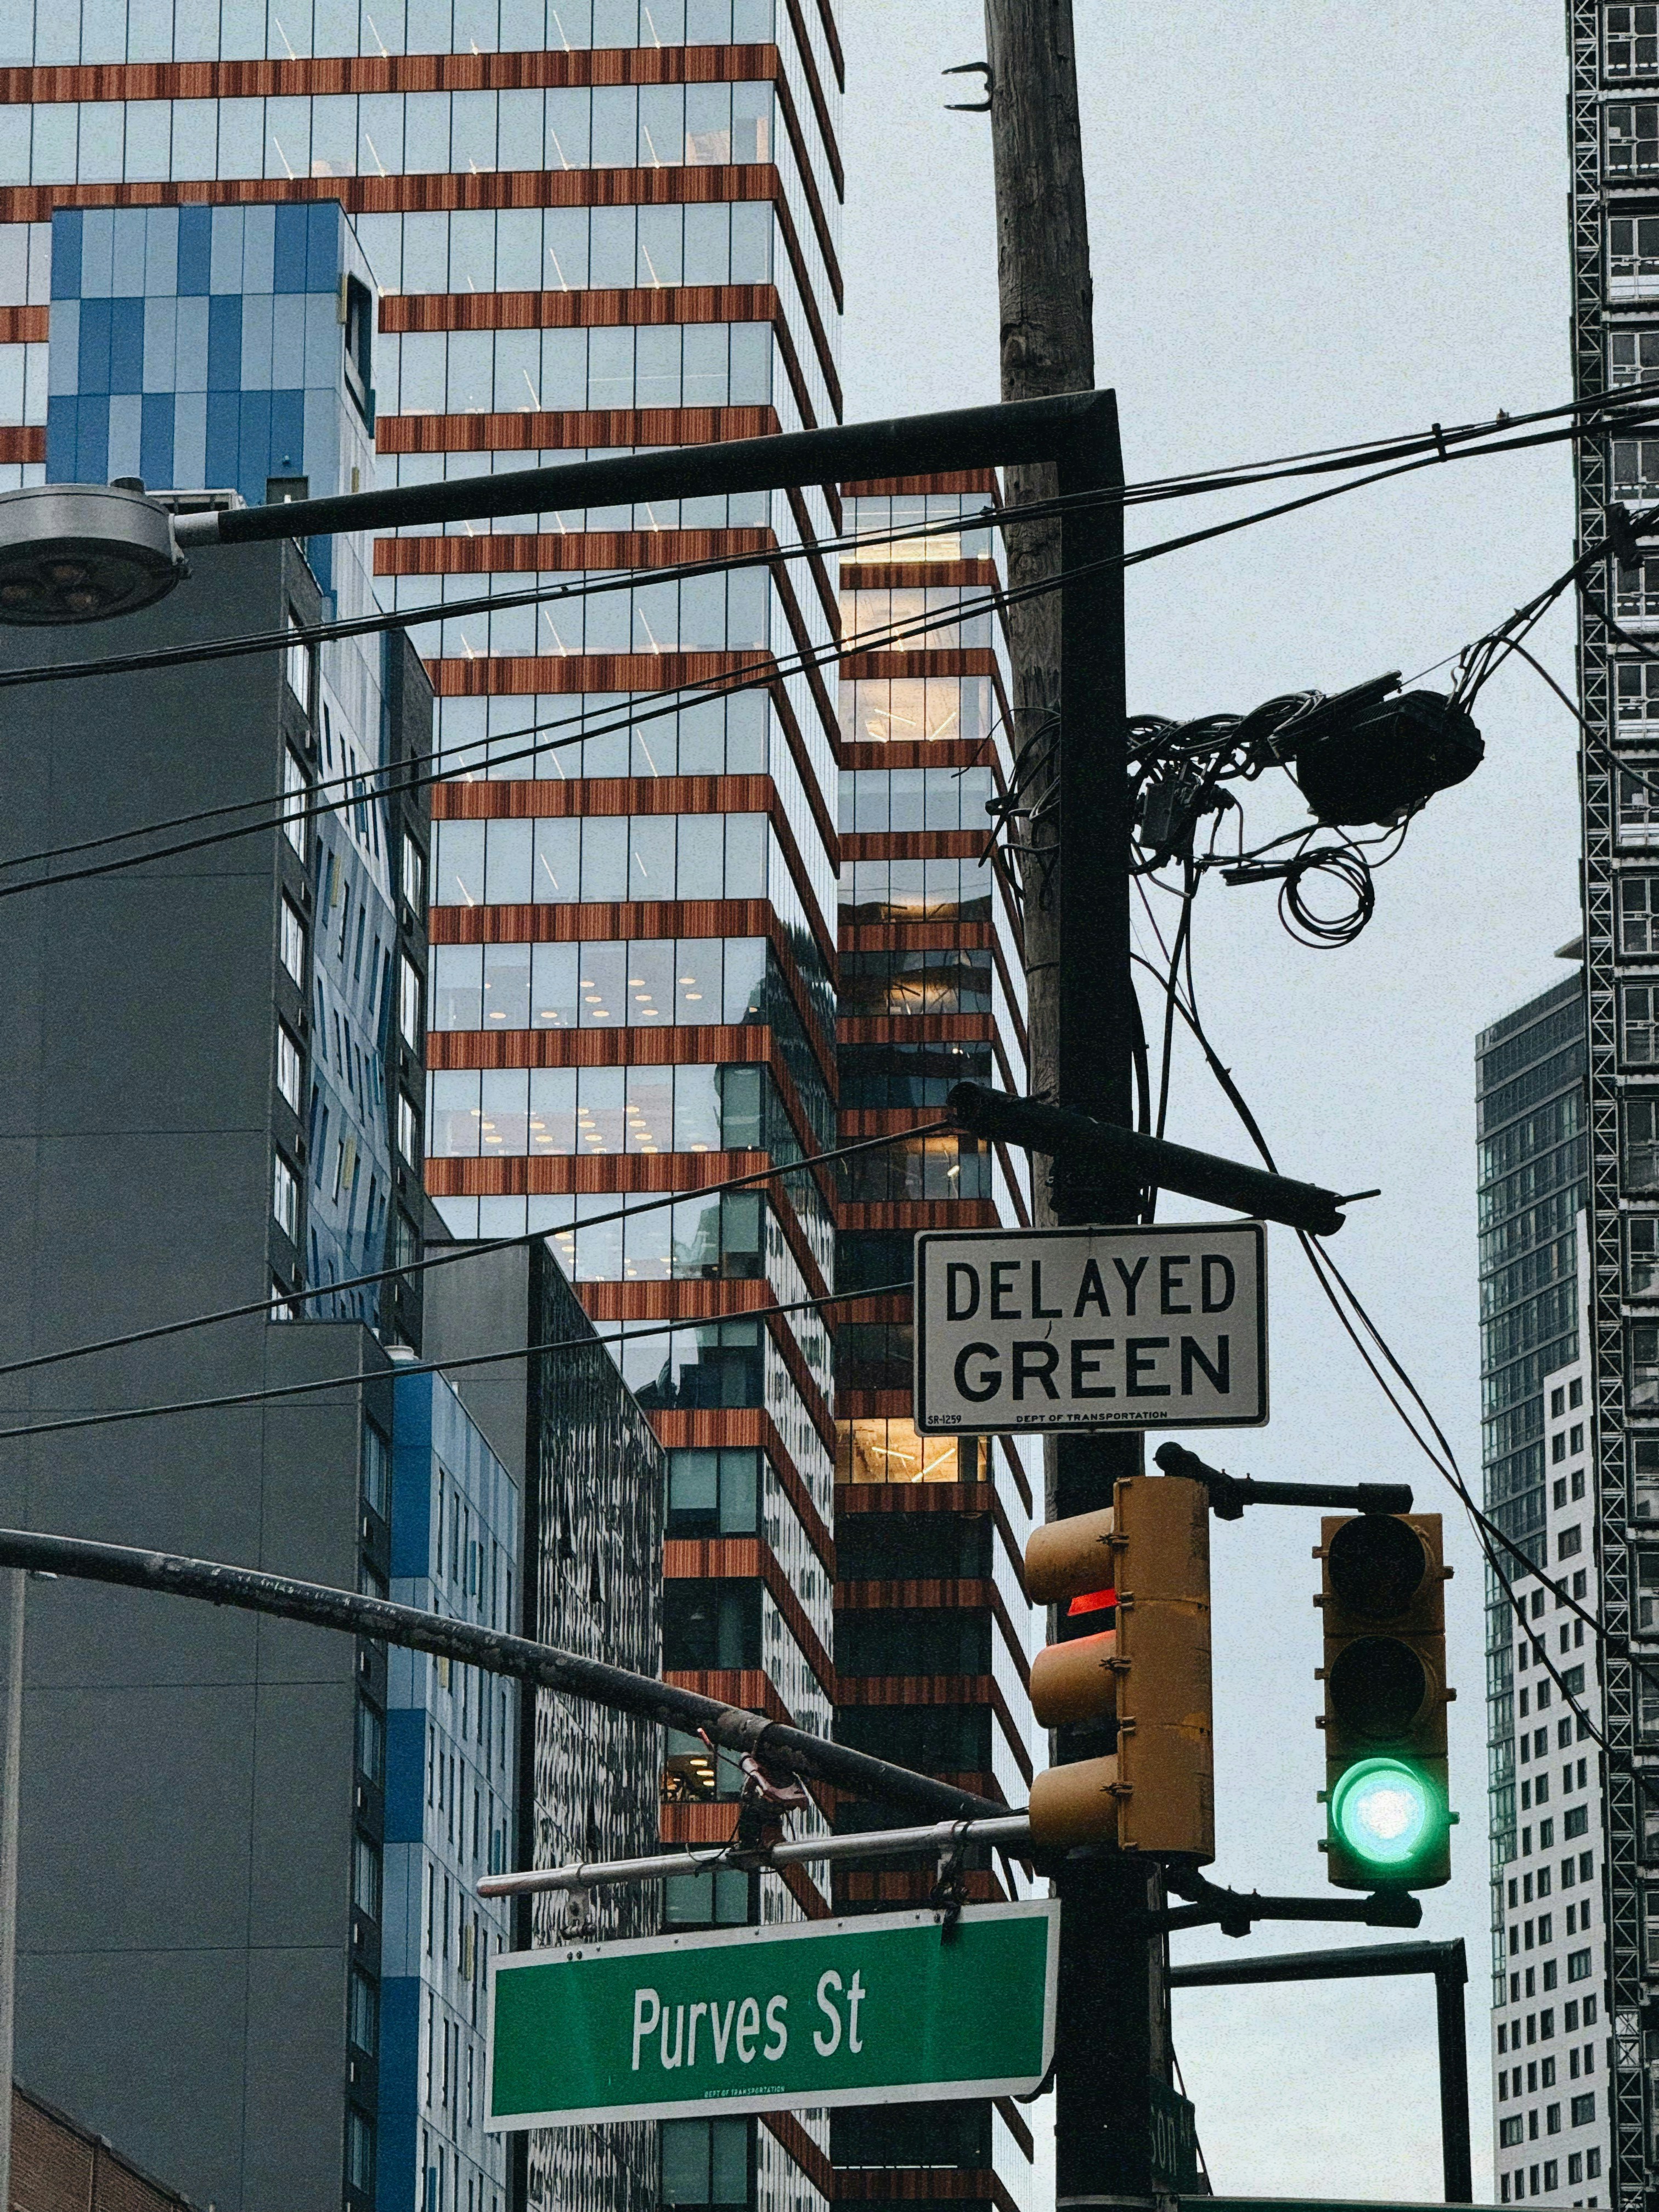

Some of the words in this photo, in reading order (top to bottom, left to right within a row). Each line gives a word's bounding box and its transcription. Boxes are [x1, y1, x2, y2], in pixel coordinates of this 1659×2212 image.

[946, 1254, 1235, 1321] DELAYED
[953, 1334, 1230, 1402] GREEN
[927, 1414, 962, 1425] SR-1259
[1016, 1414, 1045, 1423] DEPT
[1048, 1413, 1063, 1422] OF
[1066, 1411, 1167, 1421] TRANSPORTATION
[631, 1988, 788, 2072] Purves
[813, 1968, 866, 2057] St
[704, 2090, 721, 2098] DEPT
[731, 2086, 785, 2095] TRANSPORTATION
